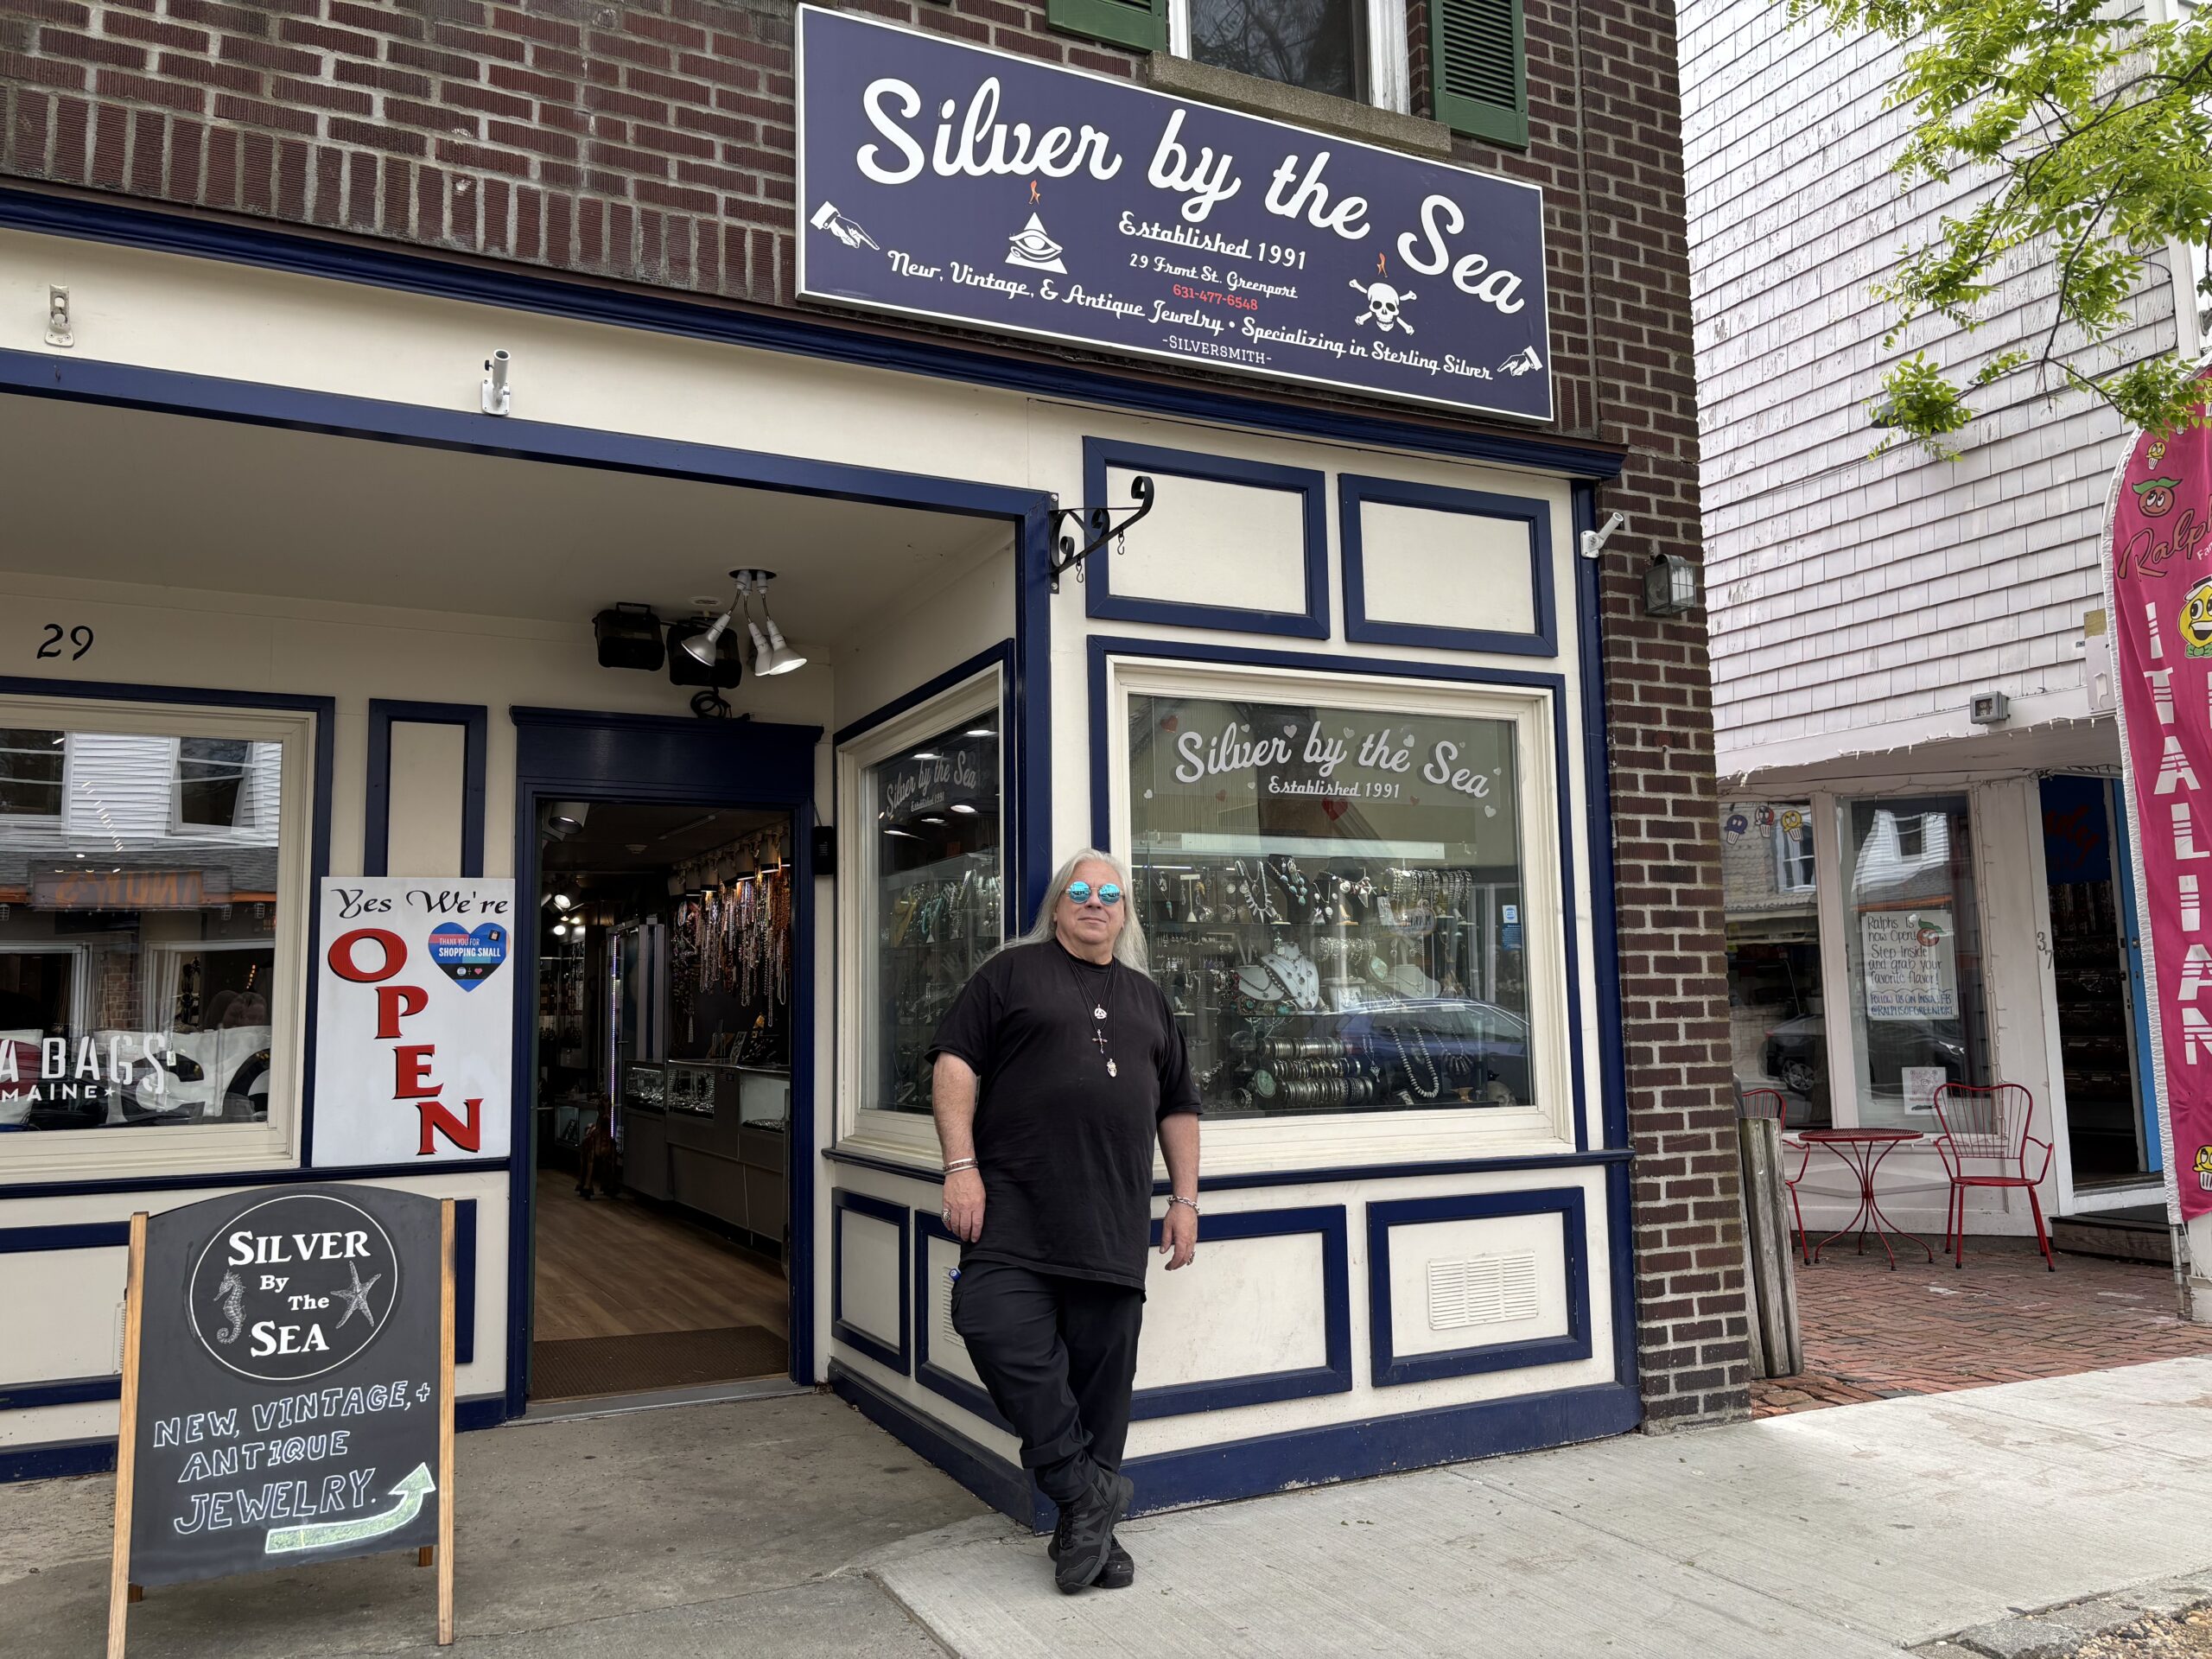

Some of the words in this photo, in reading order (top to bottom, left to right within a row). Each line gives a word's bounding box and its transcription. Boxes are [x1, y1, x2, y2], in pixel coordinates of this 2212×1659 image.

[856, 76, 1123, 185] Silver
[1147, 108, 1242, 223] by
[1264, 151, 1370, 240] the
[1396, 194, 1525, 315] Sea
[1118, 210, 1253, 259] Established
[1258, 242, 1306, 270] 1991
[1128, 252, 1149, 269] 29
[1153, 256, 1199, 280] Front
[1200, 265, 1223, 284] St.
[1226, 270, 1299, 299] Greenport
[887, 250, 944, 282] New,
[950, 261, 1035, 300] Vintage,
[1039, 278, 1059, 300] &
[1062, 283, 1146, 319] Antique
[1147, 299, 1224, 337] Jewelry
[1241, 316, 1347, 359] Specializing
[1349, 338, 1370, 359] in
[1371, 340, 1441, 376] Sterling
[1443, 353, 1494, 381] Silver
[1173, 283, 1258, 311] 631-477-6548
[1162, 334, 1273, 365] -SILVERSMITH-
[2118, 493, 2212, 582] Ralp
[36, 623, 95, 662] 29
[1174, 721, 1292, 784] Silver
[1302, 720, 1348, 778] by
[1357, 728, 1412, 773] the
[1422, 740, 1491, 798] Sea
[886, 772, 916, 817] Silver
[918, 760, 931, 797] by
[933, 752, 950, 784] the
[953, 750, 976, 790] Sea
[1268, 775, 1362, 797] Established
[1364, 782, 1401, 799] 1991
[330, 888, 392, 919] Yes
[405, 890, 509, 914] We're
[439, 938, 457, 946] THANK
[458, 938, 469, 946] YOU
[469, 938, 480, 946] FOR
[1867, 916, 1898, 931] Ralphs
[1868, 931, 1887, 942] now
[1890, 930, 1916, 944] Open!
[438, 947, 476, 957] SHOPPING
[477, 947, 501, 957] SMALL
[1868, 958, 1886, 970] and
[1891, 958, 1916, 974] grab
[1919, 959, 1942, 973] your
[1871, 944, 1897, 960] Step
[1871, 970, 1906, 984] favorite
[327, 927, 483, 1156] OPEN
[41, 1034, 166, 1095] BAGS
[1, 1083, 98, 1103] MAINE
[227, 1230, 371, 1267] SILVER
[259, 1274, 290, 1294] By
[288, 1294, 330, 1312] The
[250, 1320, 330, 1357] SEA
[153, 1407, 241, 1448] NEW,
[251, 1380, 412, 1434] VINTAGE,
[177, 1430, 350, 1484] ANTIQUE
[173, 1467, 378, 1535] JEWELRY.
